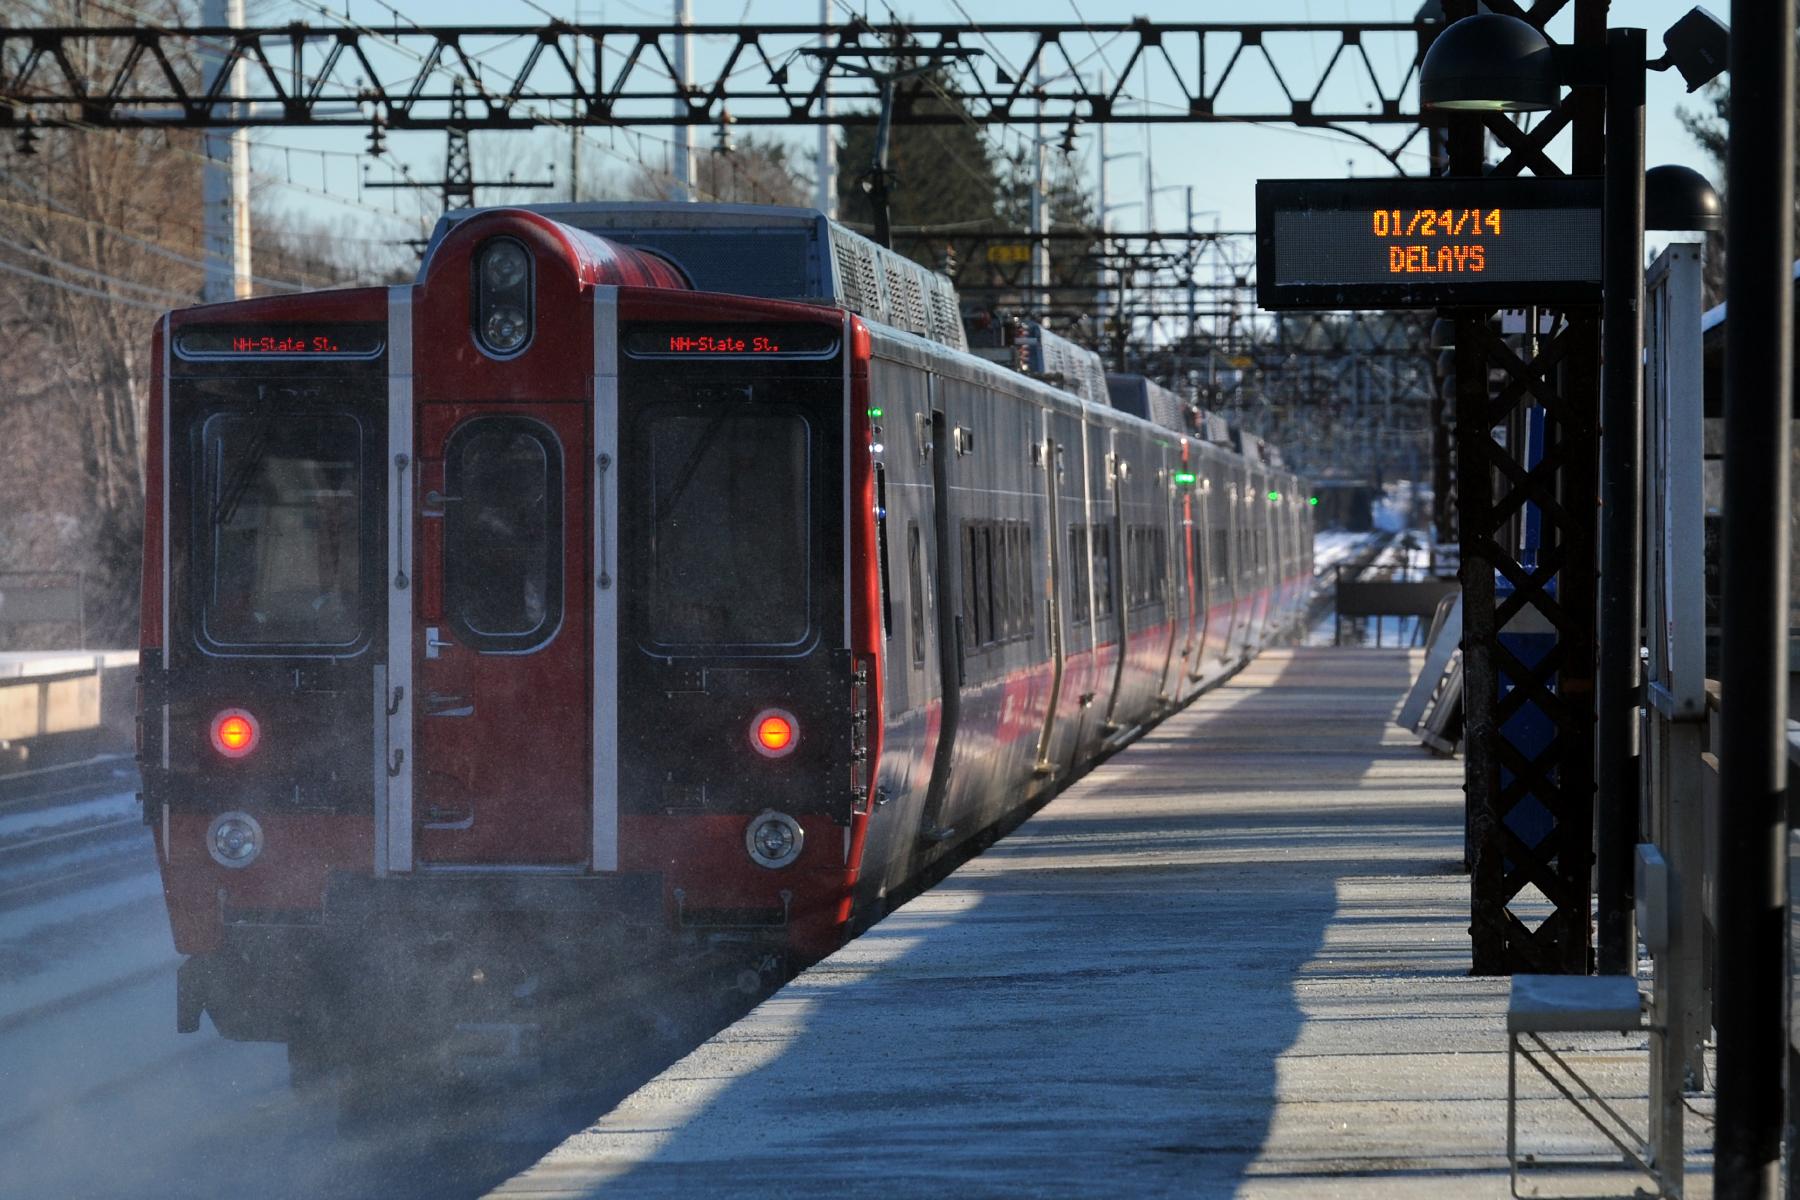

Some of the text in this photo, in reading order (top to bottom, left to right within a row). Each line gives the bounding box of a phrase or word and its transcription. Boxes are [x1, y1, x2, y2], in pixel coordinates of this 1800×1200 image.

[1373, 208, 1501, 237] 01/24/14
[1389, 245, 1485, 273] DELAYS
[233, 336, 338, 351] NH-State St.
[669, 336, 779, 351] NH-State St.
